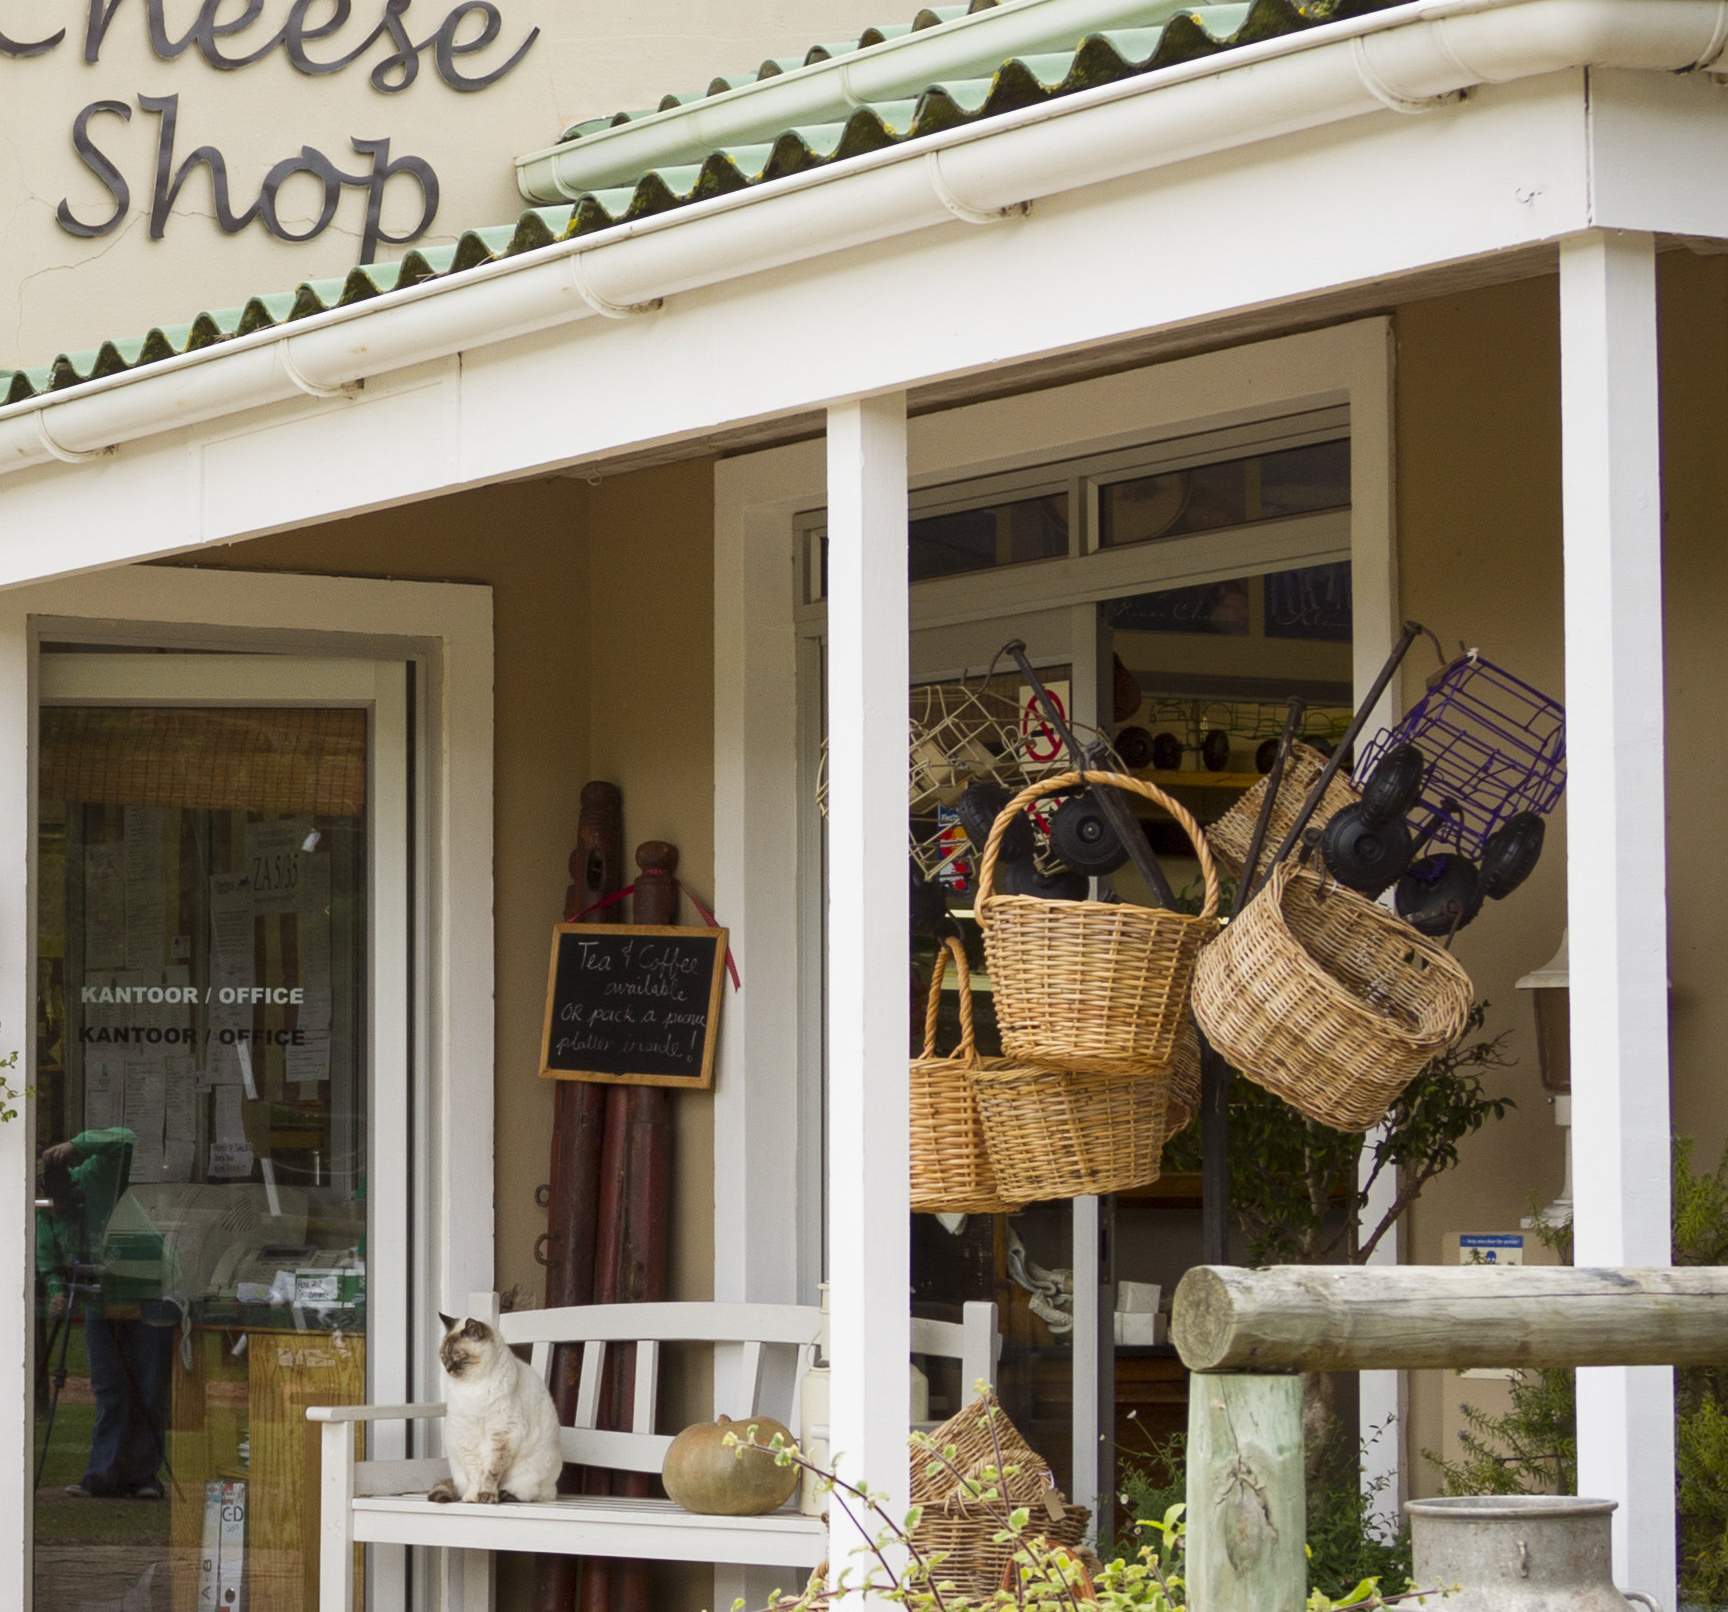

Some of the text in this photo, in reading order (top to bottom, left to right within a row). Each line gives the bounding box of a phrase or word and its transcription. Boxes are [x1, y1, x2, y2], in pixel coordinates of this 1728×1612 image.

[56, 92, 440, 265] Shop
[254, 856, 271, 891] ZA
[578, 941, 612, 971] Tea
[638, 944, 699, 979] Coffee
[81, 987, 304, 1005] KANTOOR / OFFICE
[605, 974, 688, 1002] available
[560, 1002, 584, 1022] OR
[587, 1004, 635, 1028] pack
[641, 1009, 657, 1023] a
[78, 1027, 198, 1045] KANTOOR
[220, 1028, 305, 1046] OFFICE
[557, 1032, 612, 1056] platter
